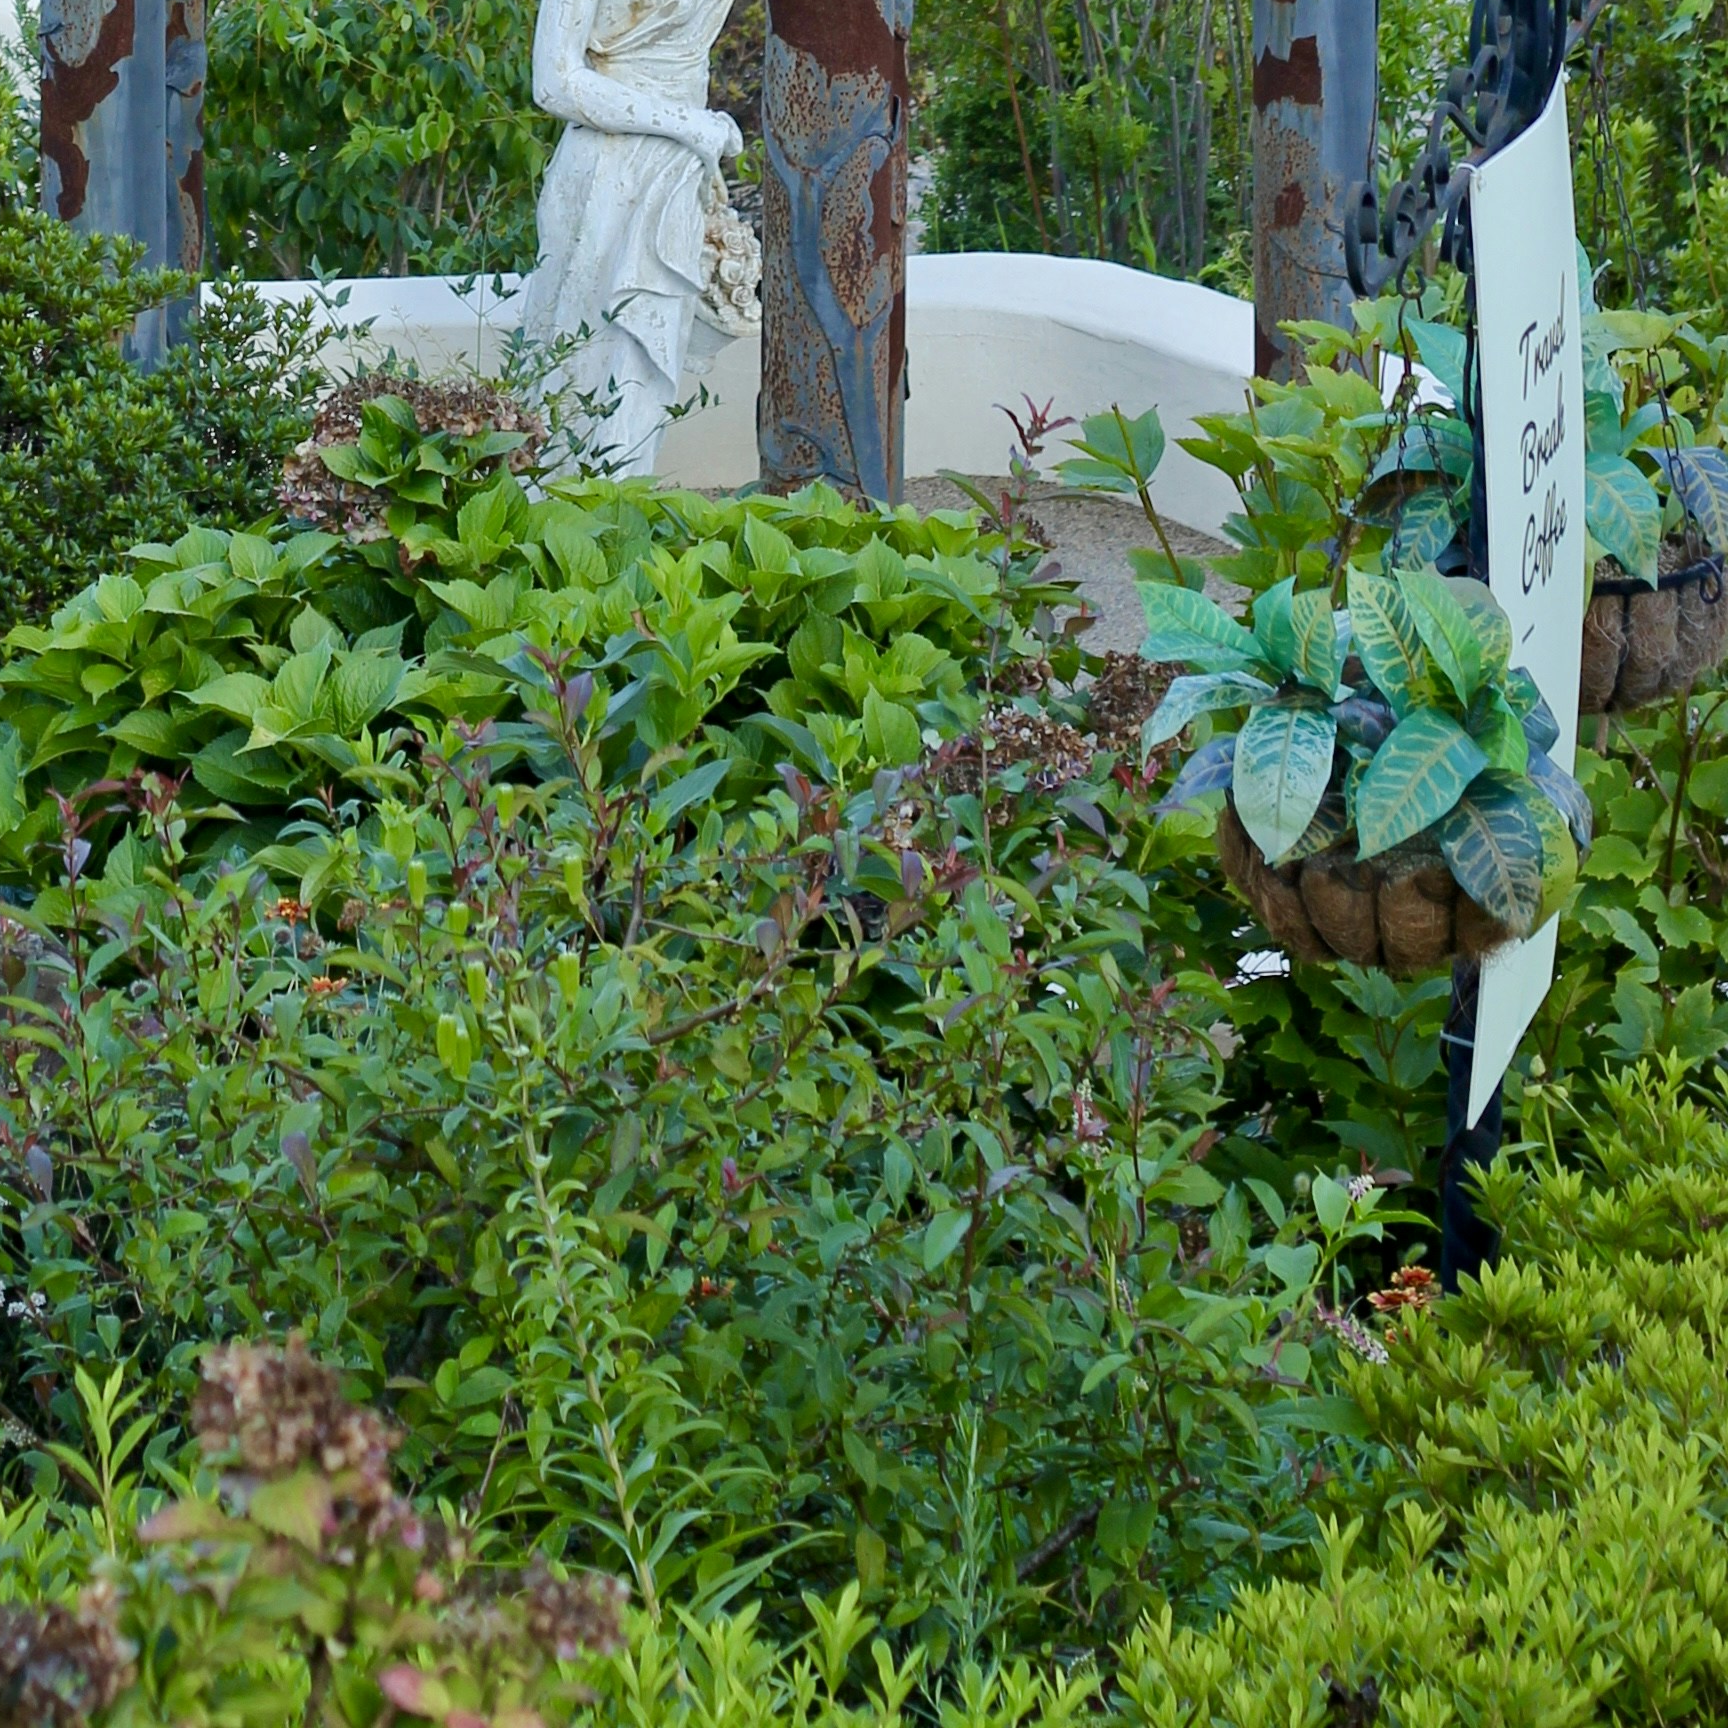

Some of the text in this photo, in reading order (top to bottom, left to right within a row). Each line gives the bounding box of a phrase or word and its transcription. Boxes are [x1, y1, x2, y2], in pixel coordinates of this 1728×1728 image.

[1519, 271, 1566, 401] Travel
[1520, 371, 1565, 494] Break
[1521, 480, 1568, 595] Coffee
